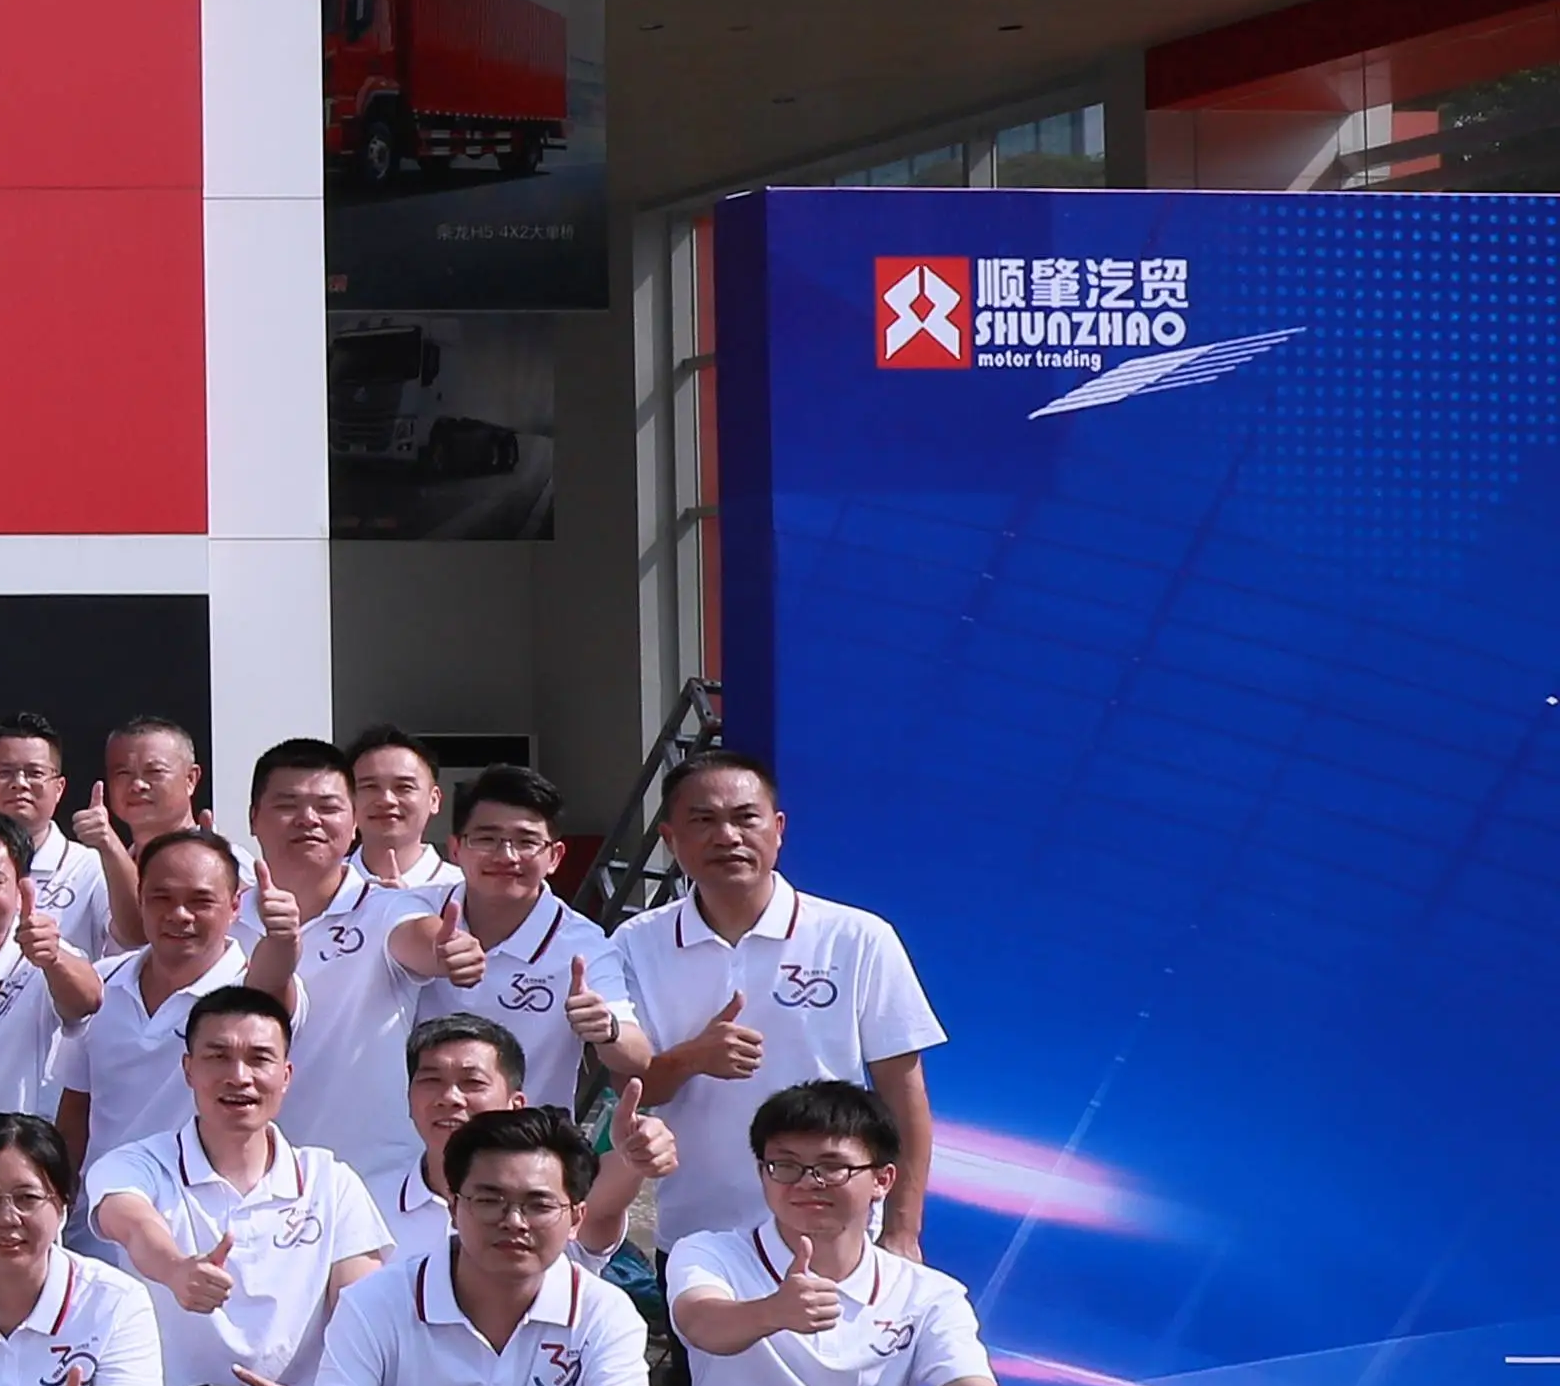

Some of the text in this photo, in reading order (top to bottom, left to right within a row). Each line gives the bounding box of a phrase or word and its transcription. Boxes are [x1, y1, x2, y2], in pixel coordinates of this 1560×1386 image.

[977, 258, 1189, 309] 顺肇汽贸
[975, 311, 1187, 347] SHUNZHAO
[978, 349, 1102, 372] motor trading
[497, 973, 554, 1013] 30
[772, 963, 838, 1009] 30
